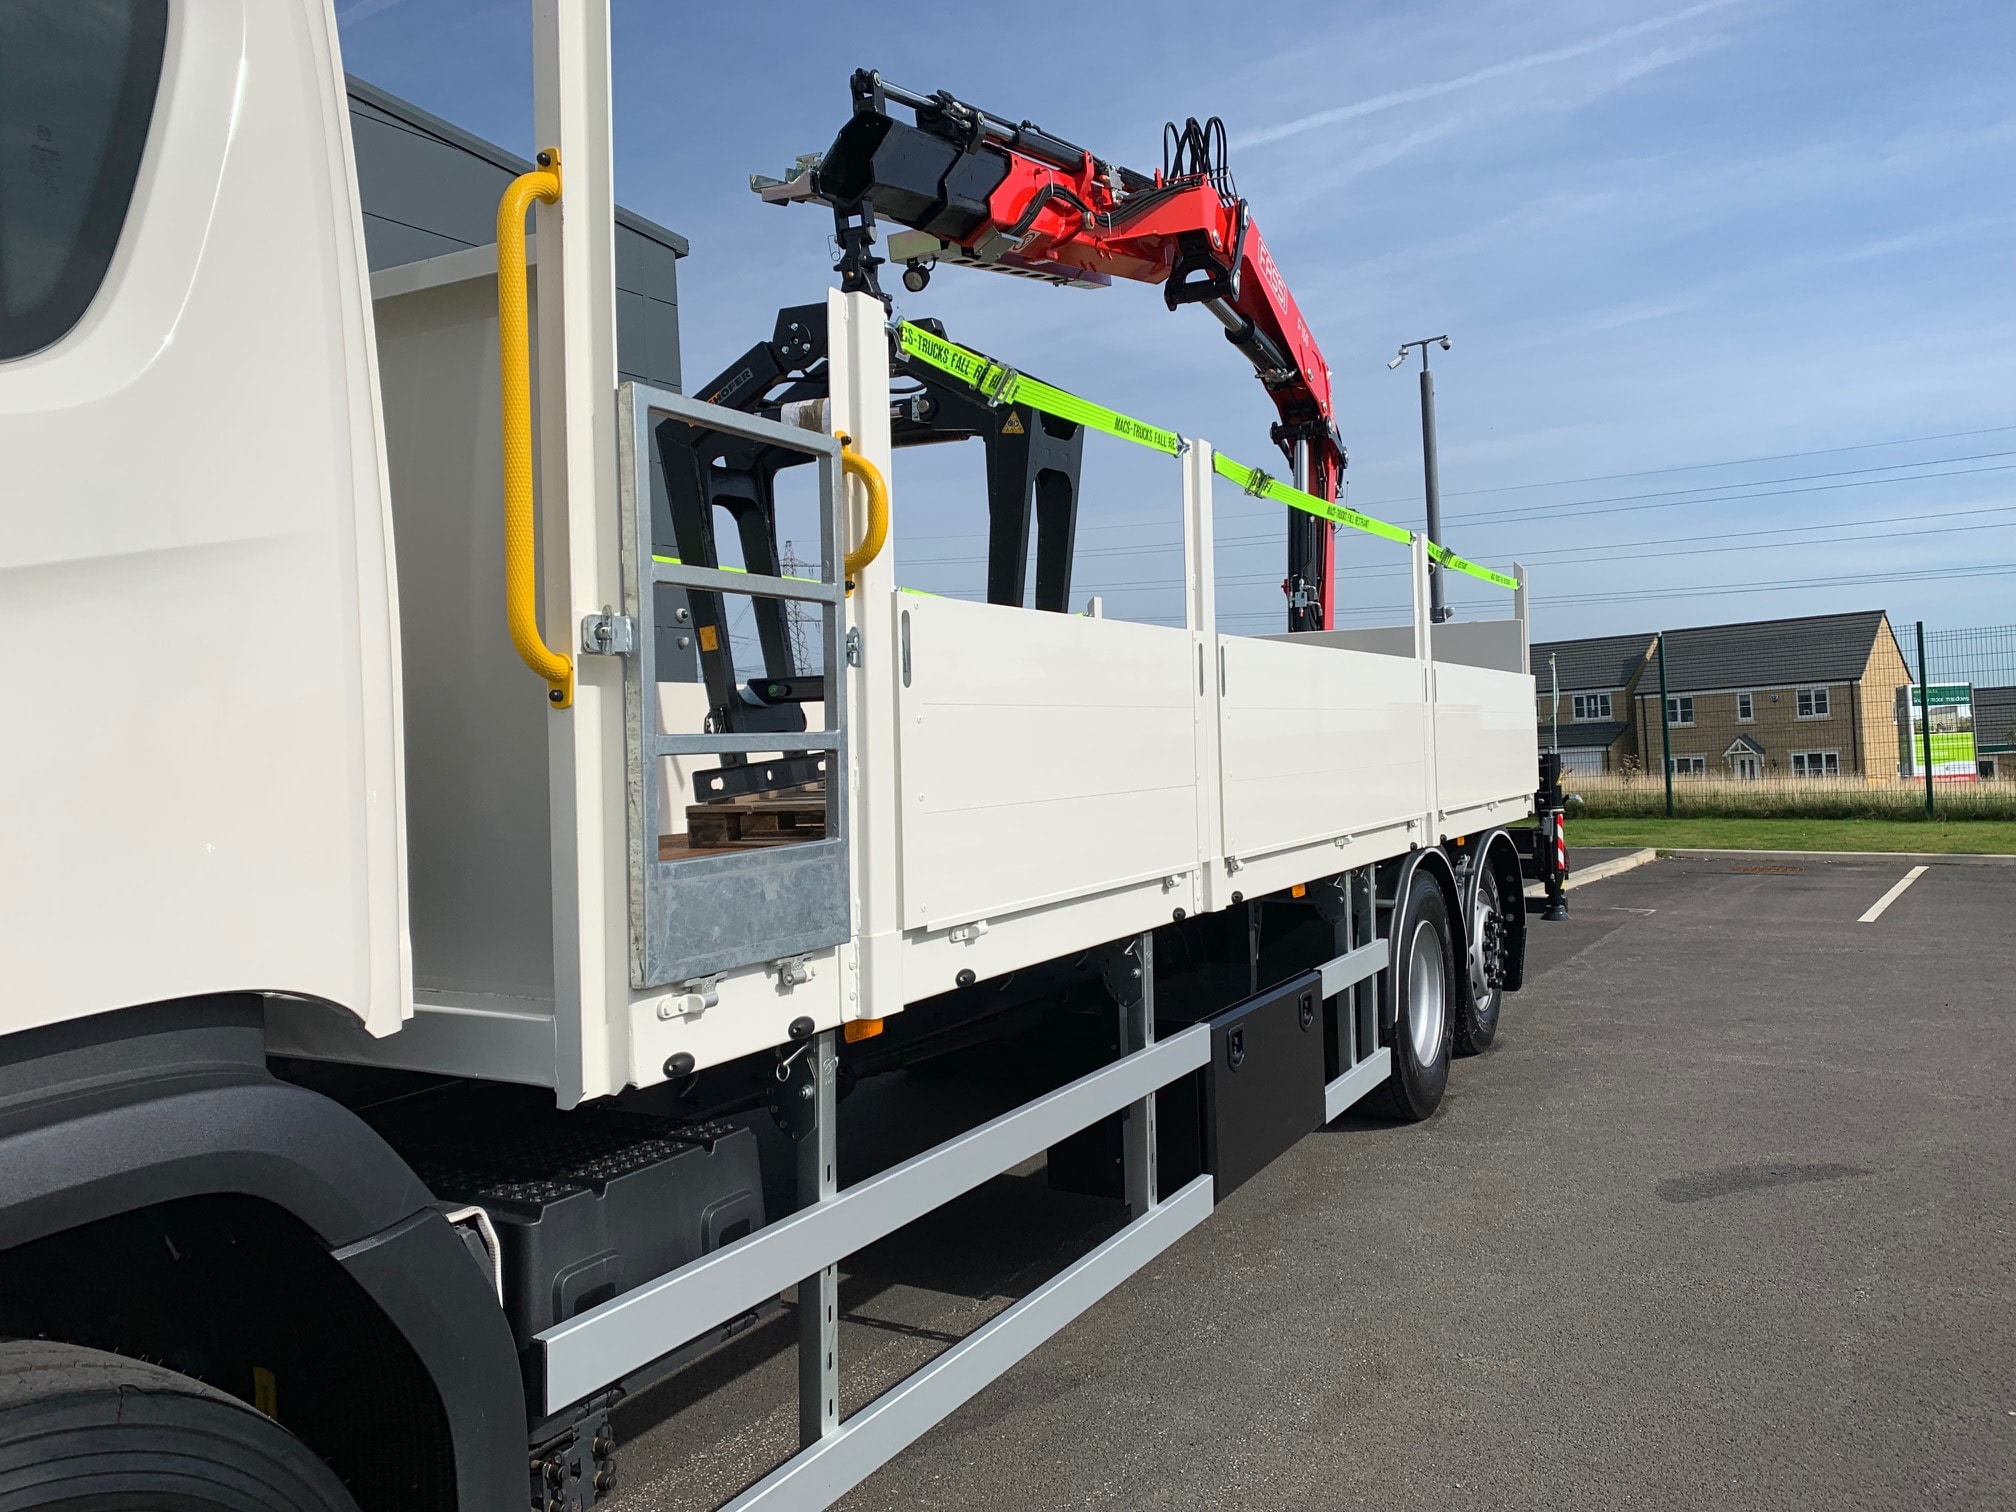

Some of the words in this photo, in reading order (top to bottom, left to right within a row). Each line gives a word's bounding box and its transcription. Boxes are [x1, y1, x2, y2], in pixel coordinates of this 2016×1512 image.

[1259, 242, 1286, 312] FASSI
[950, 353, 971, 376] FALL
[1114, 416, 1152, 443] MACS-TRUCKS
[1154, 431, 1167, 448] FALL
